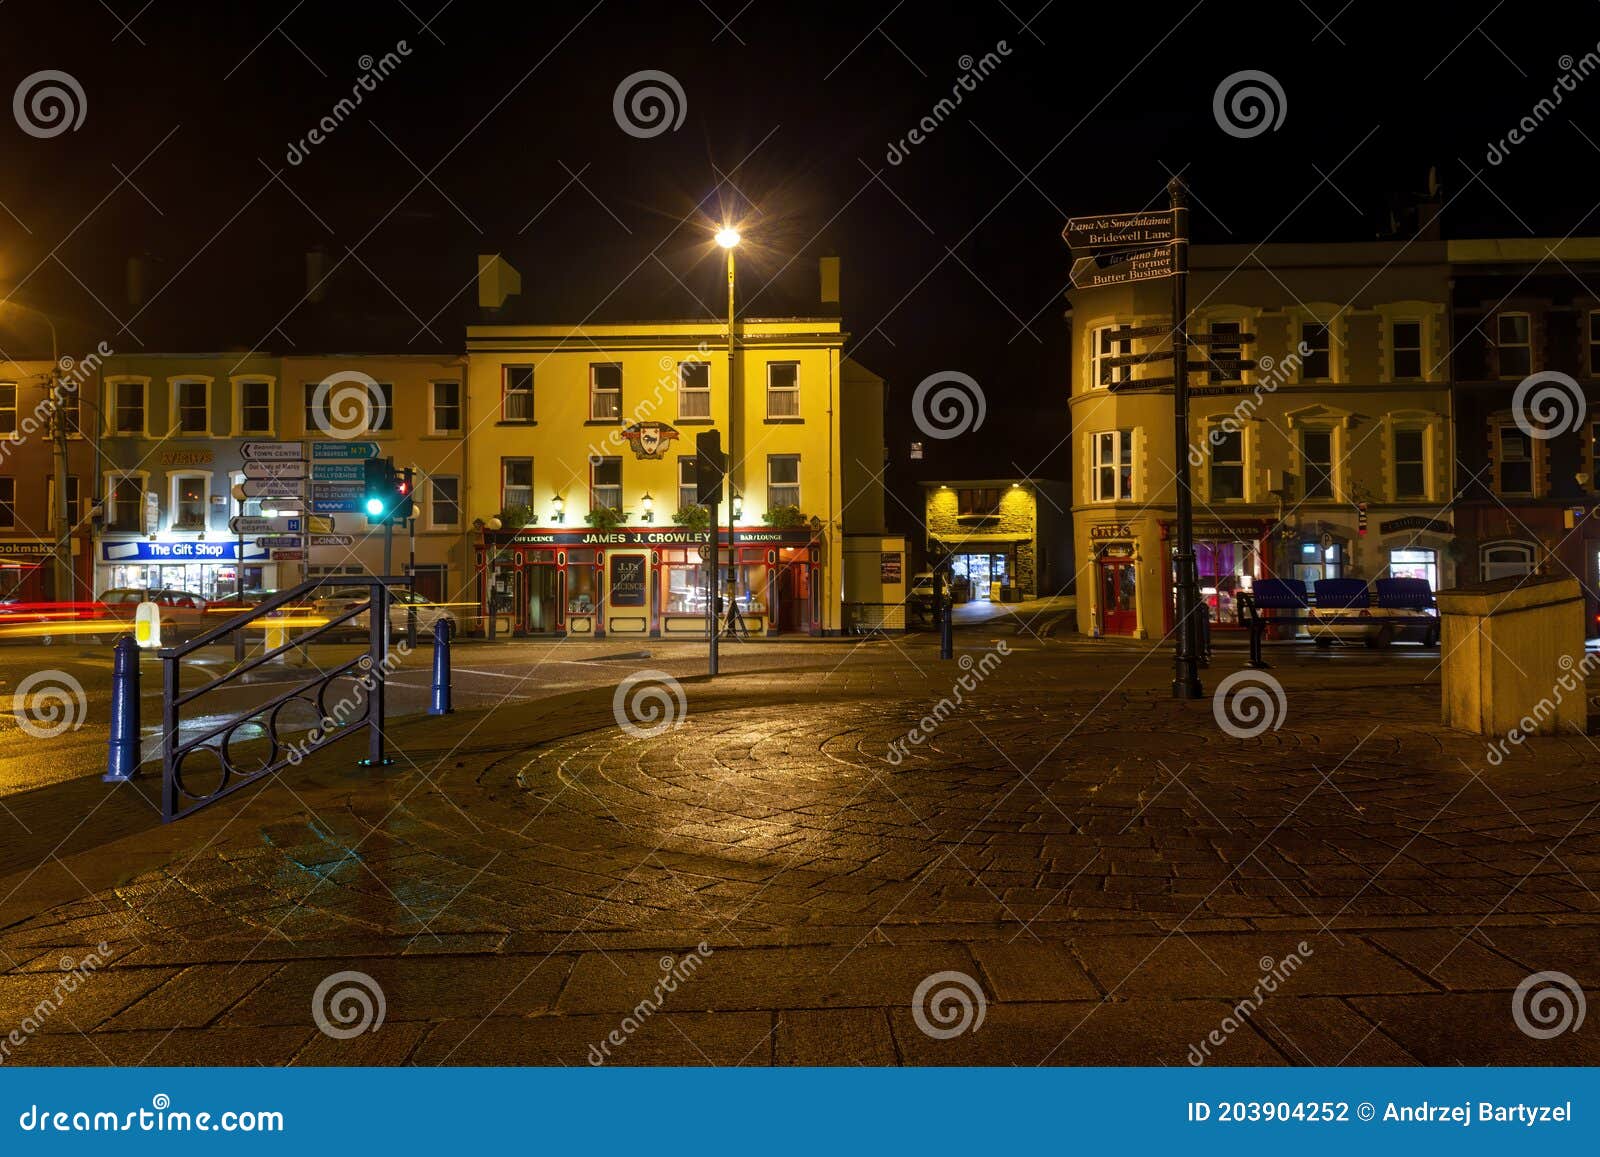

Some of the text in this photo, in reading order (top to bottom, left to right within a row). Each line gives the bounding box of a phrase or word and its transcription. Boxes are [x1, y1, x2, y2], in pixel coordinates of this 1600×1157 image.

[1096, 219, 1109, 229] Na
[1089, 231, 1171, 244] Bridewell Lane
[1132, 258, 1171, 269] Former
[1093, 268, 1172, 284] Butter Business
[318, 536, 349, 545] CINEMA
[582, 532, 711, 544] JAMES J. CROWLEY
[149, 544, 223, 557] The Gift Shop
